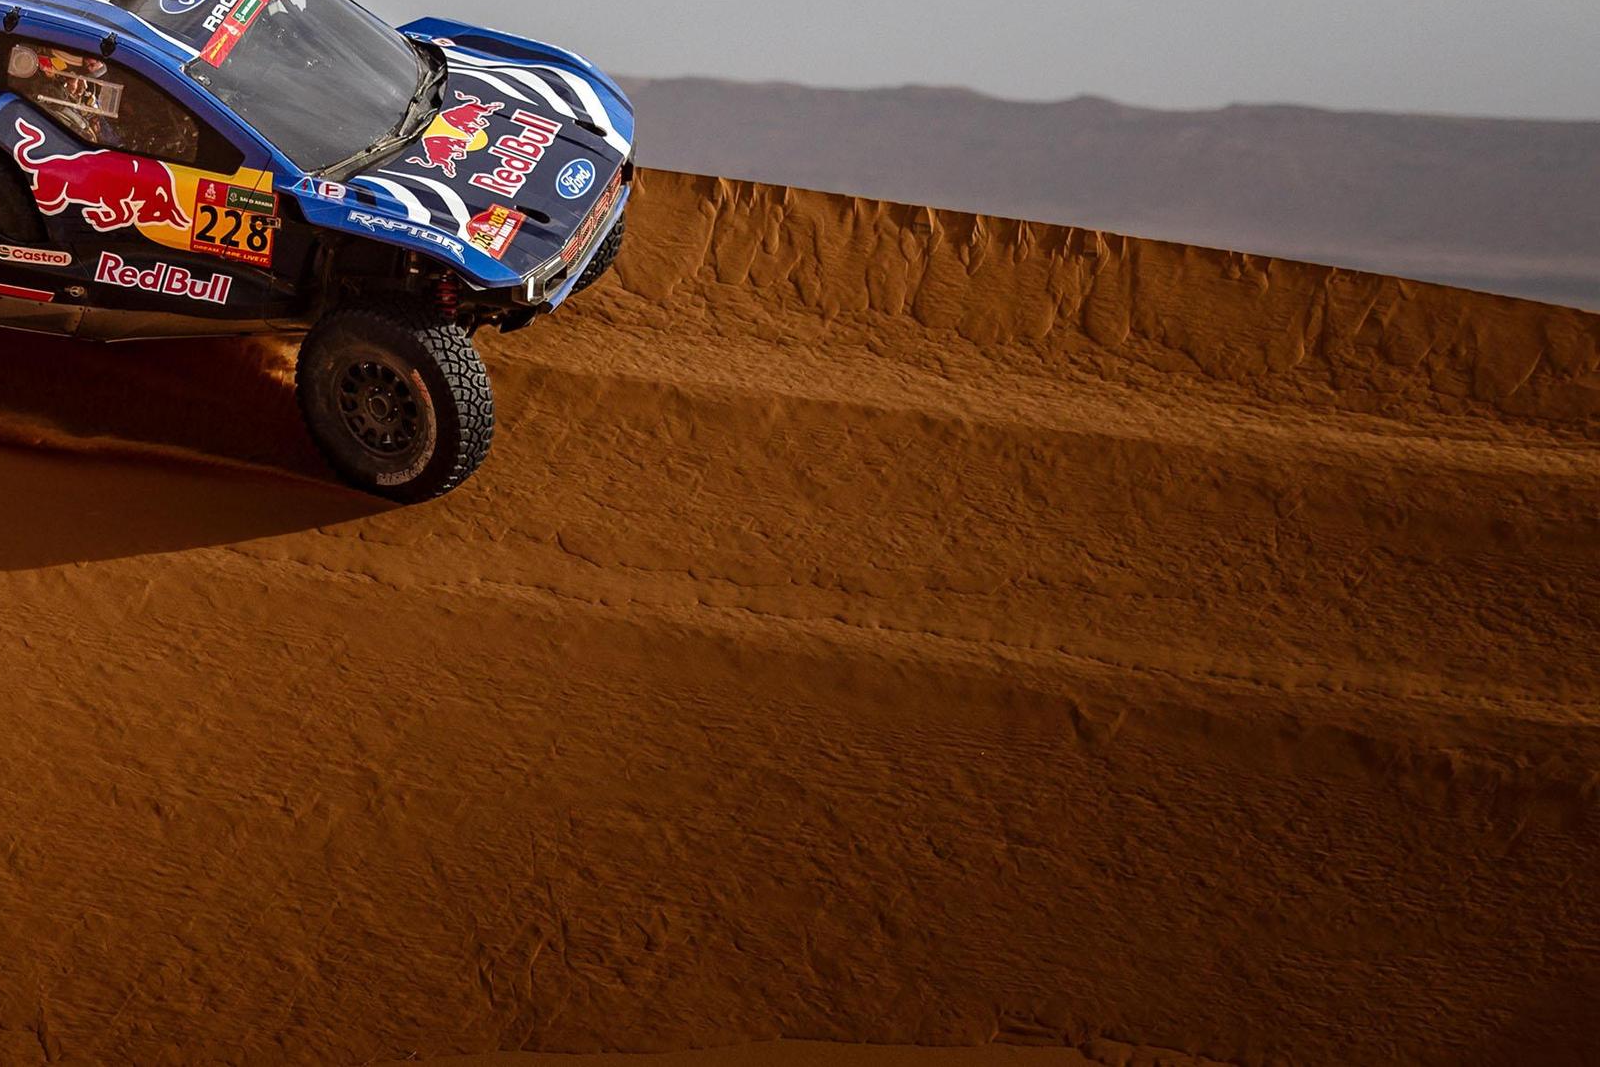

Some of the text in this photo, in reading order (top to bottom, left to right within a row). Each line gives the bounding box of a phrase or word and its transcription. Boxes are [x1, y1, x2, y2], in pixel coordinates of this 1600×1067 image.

[468, 108, 563, 199] Red Bull
[560, 165, 591, 194] Ford
[195, 205, 268, 252] 228
[348, 210, 465, 264] RAPTOR
[12, 249, 67, 264] Castrol
[94, 251, 233, 305] Red Bull
[243, 254, 258, 262] LIVE
